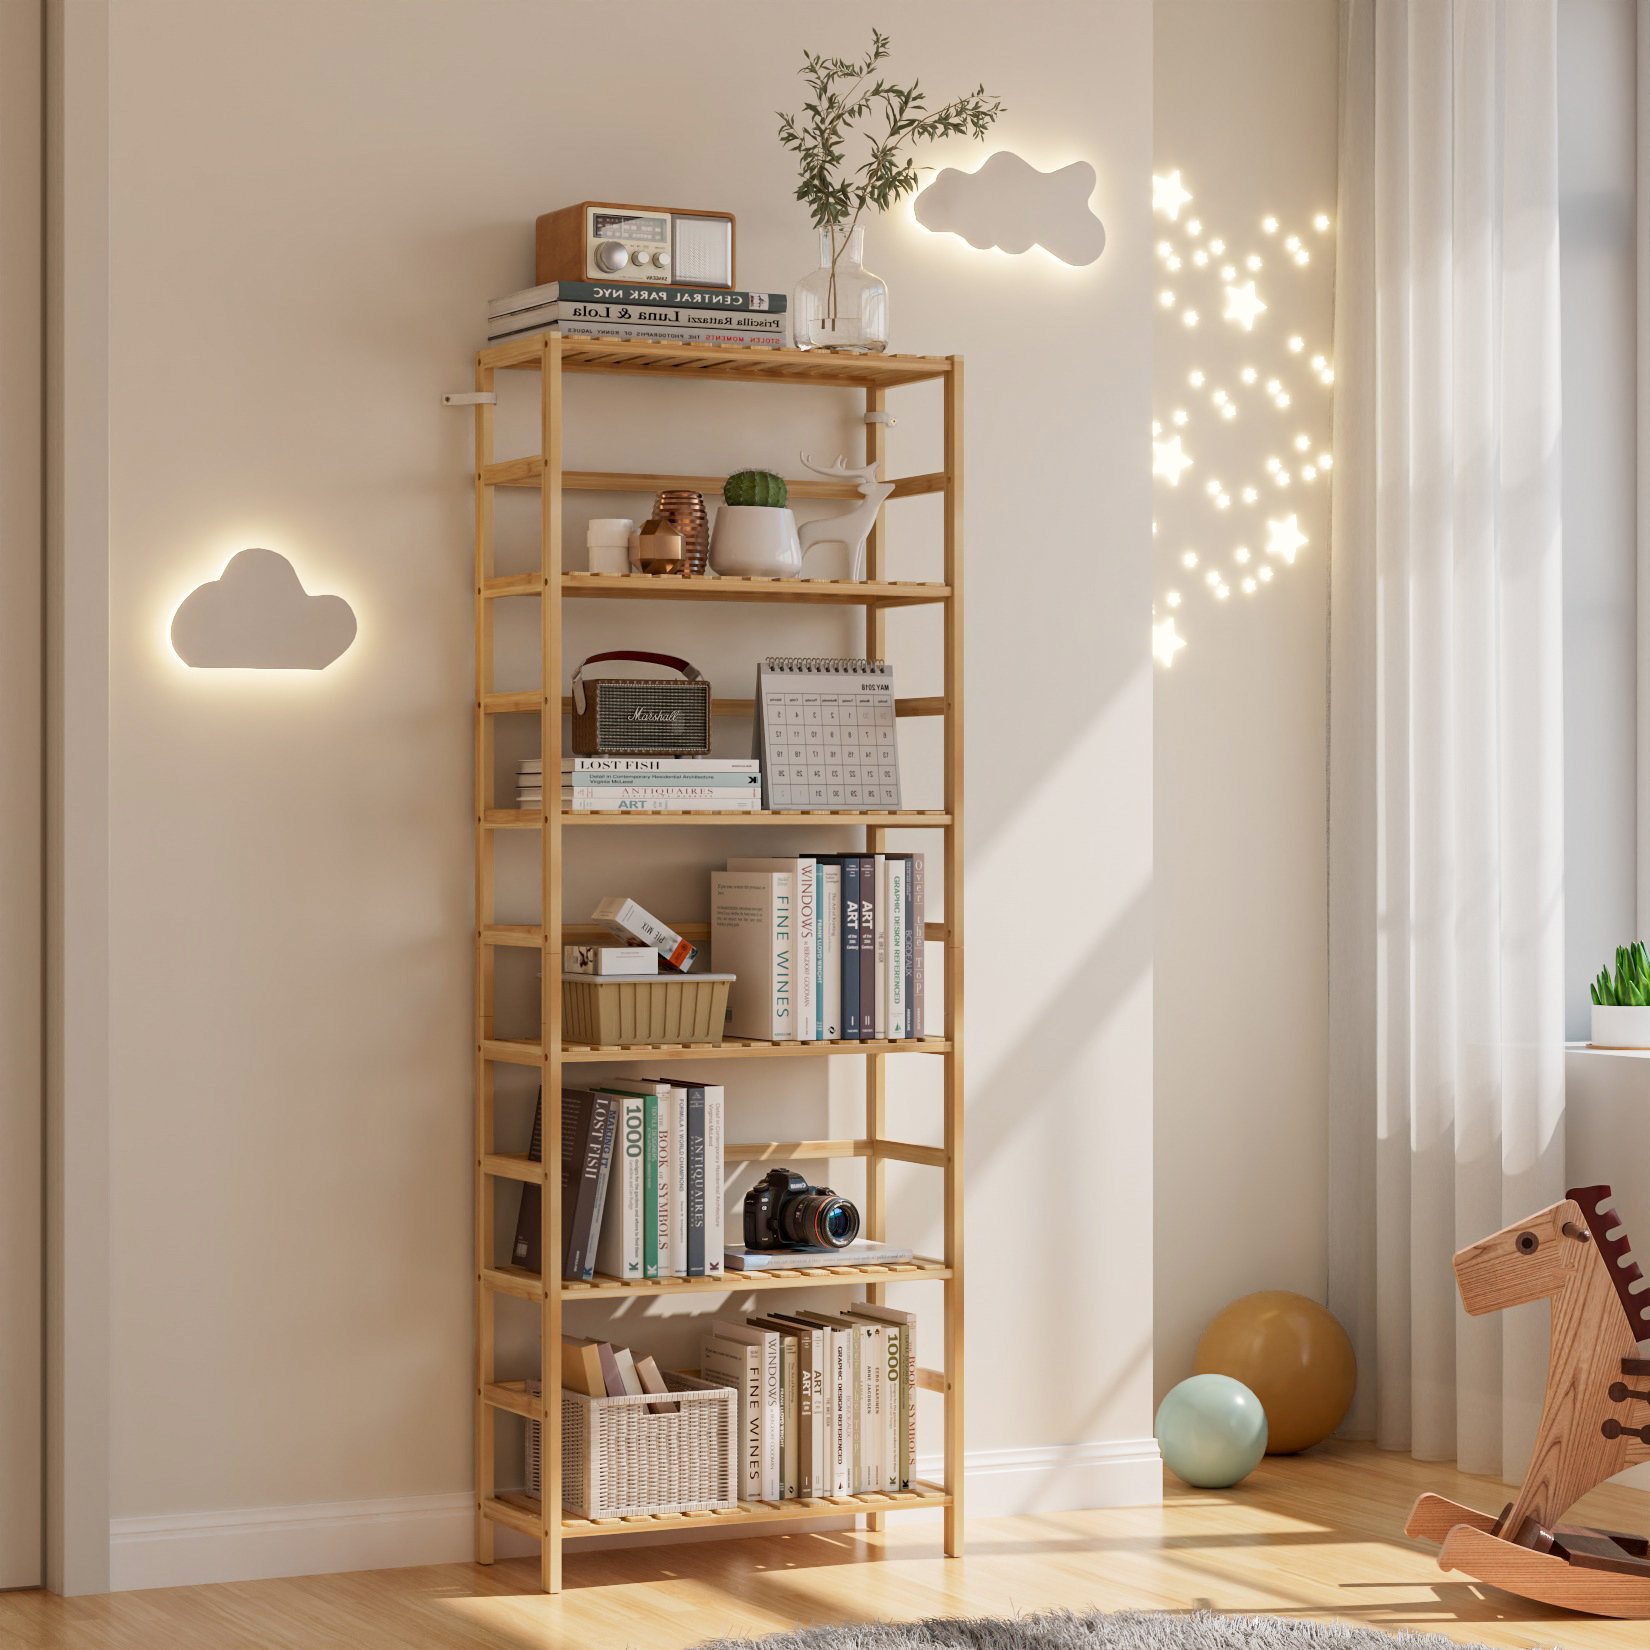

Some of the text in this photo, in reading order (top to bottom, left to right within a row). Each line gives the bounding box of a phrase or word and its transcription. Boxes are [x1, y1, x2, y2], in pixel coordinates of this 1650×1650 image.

[628, 706, 681, 721] Marshall
[581, 761, 660, 770] LOST FISH
[618, 800, 647, 808] ART
[801, 865, 813, 938] WINDOWS
[847, 901, 858, 929] ART
[862, 901, 872, 929] ART
[641, 921, 665, 943] PIE MIX
[777, 896, 789, 1018] FINE WINES
[593, 1099, 608, 1141] LOST
[601, 1110, 616, 1168] MAKING IT
[626, 1105, 642, 1158] 1000
[585, 1144, 601, 1179] FISH
[659, 1130, 668, 1168] BOOK
[694, 1135, 703, 1228] ANTIQUAIRES
[659, 1183, 668, 1250] SYMBOLS
[768, 1339, 777, 1406] WINDOWS
[887, 1334, 898, 1382] 1000
[802, 1371, 810, 1396] ART
[814, 1370, 822, 1395] ART
[750, 1368, 759, 1480] FINE WINES
